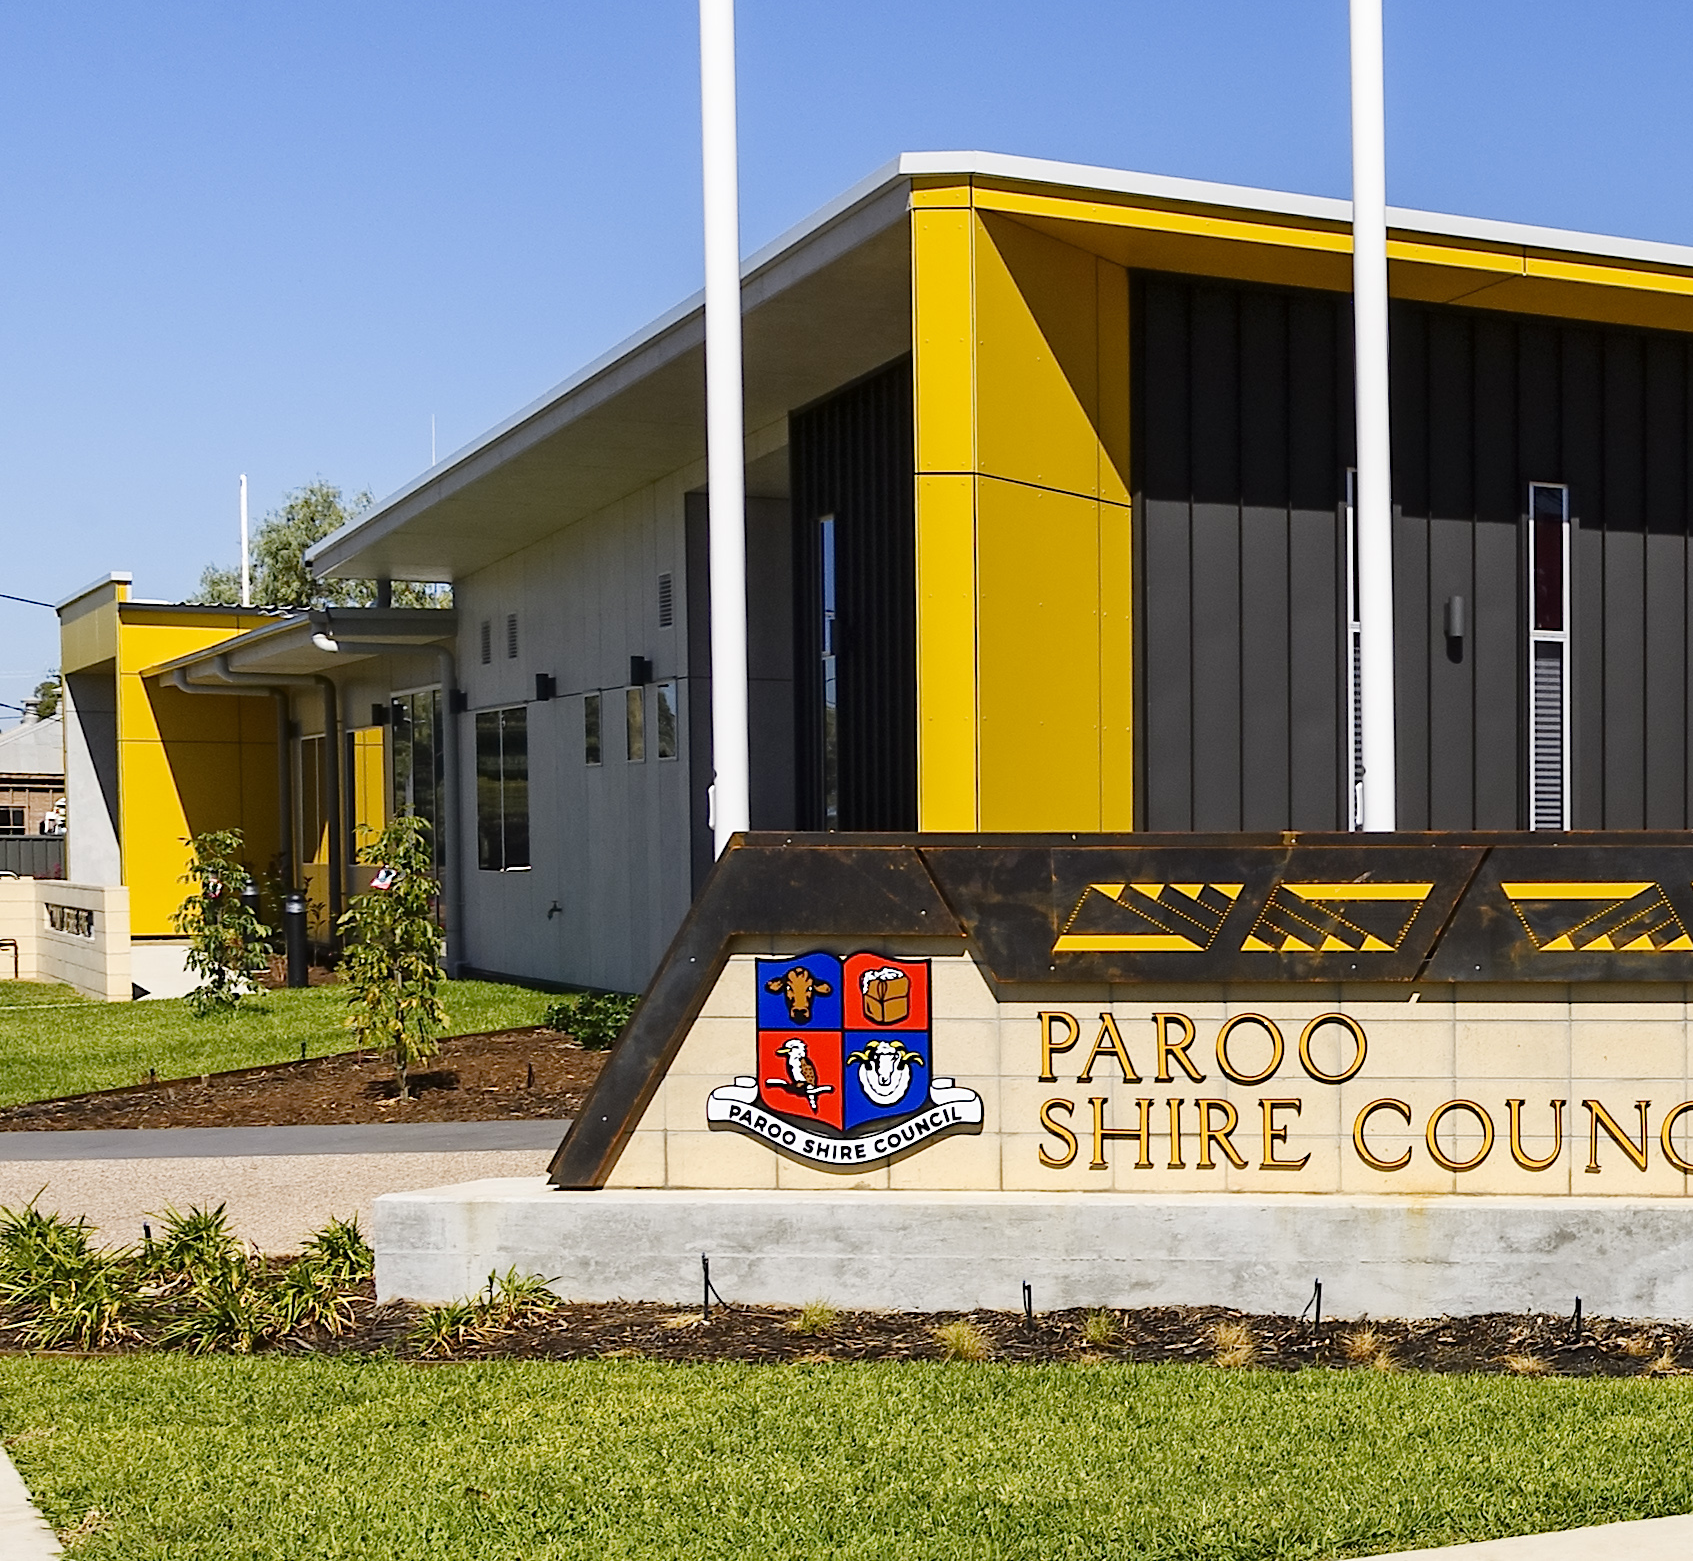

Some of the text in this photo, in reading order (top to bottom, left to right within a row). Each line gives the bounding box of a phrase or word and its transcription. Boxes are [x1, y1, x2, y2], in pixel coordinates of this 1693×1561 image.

[1037, 1011, 1368, 1086] PAROO
[728, 1104, 963, 1160] PAROO SHIRE COUNCIL
[1038, 1097, 1312, 1170] SHIRE
